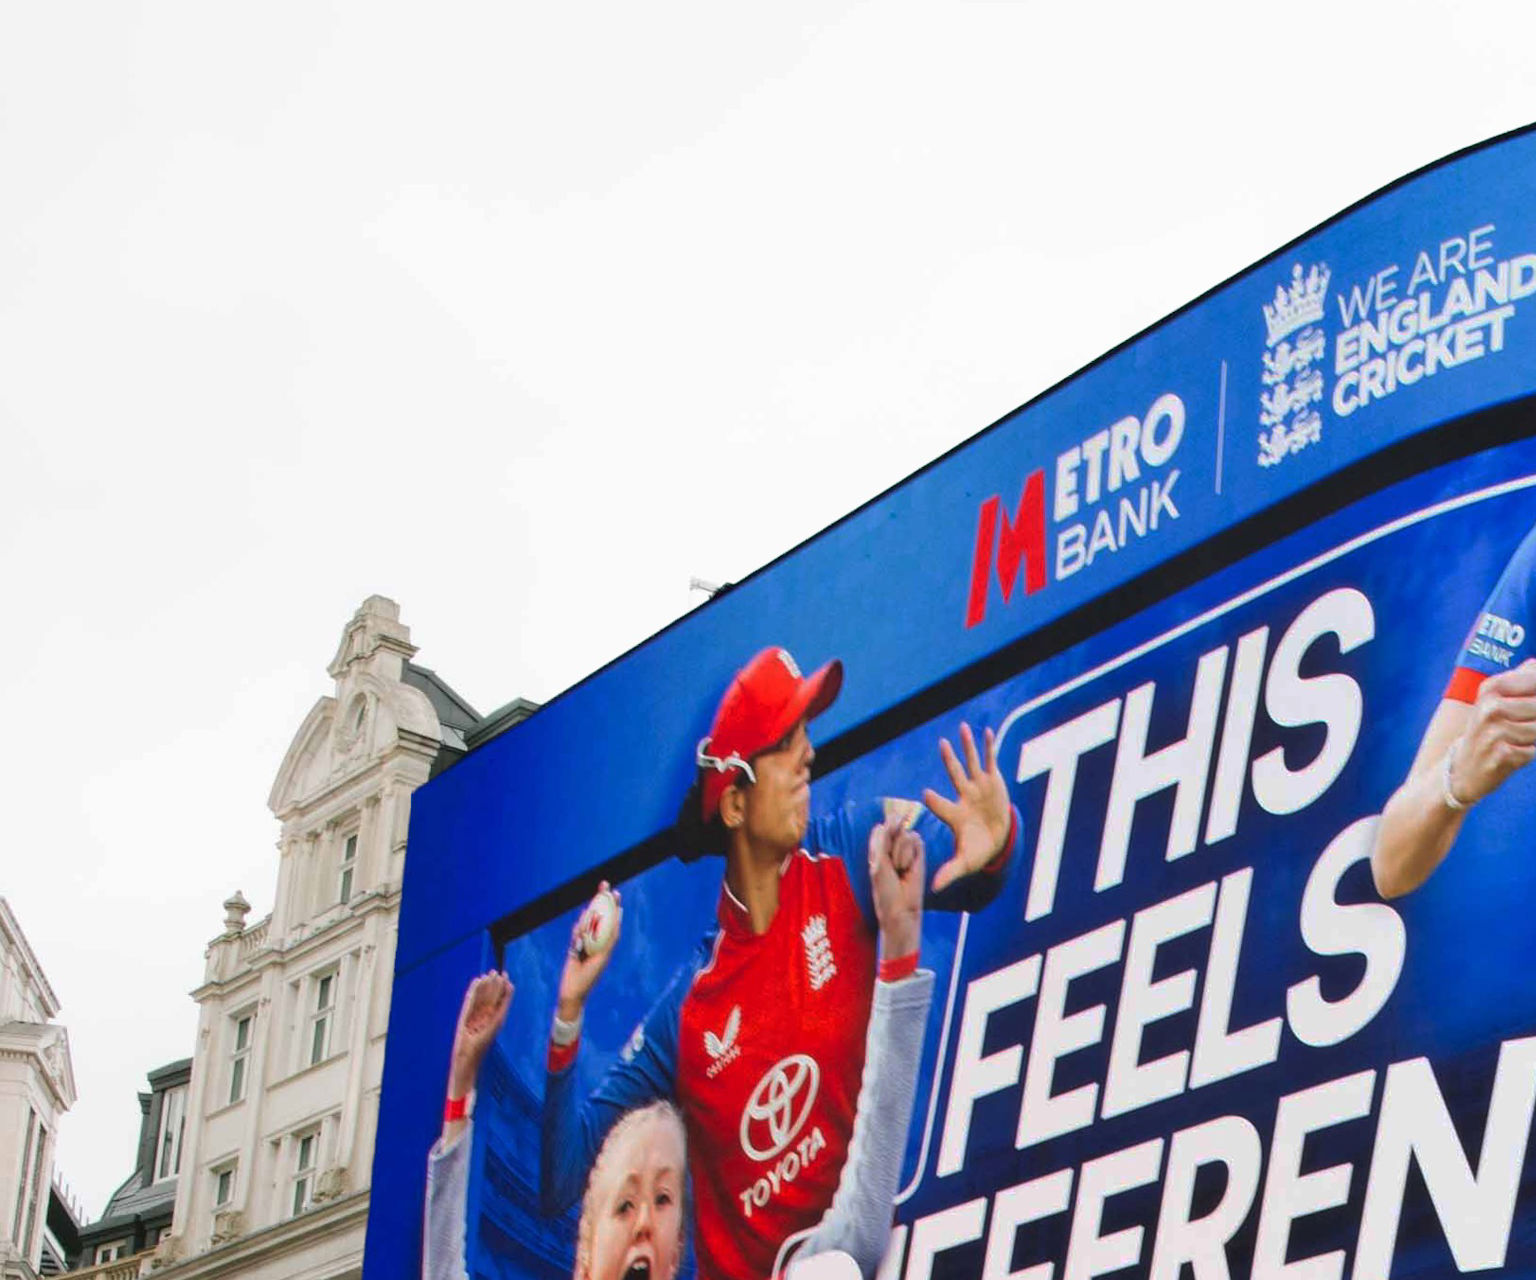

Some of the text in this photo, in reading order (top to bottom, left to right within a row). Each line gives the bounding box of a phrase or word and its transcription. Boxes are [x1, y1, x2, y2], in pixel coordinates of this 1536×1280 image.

[1337, 224, 1497, 328] WE ARE
[1331, 304, 1516, 417] CRICKET
[965, 393, 1187, 629] METRO
[1055, 469, 1183, 582] BANK
[1016, 587, 1377, 923] THIS
[935, 814, 1408, 1178] FEELS
[739, 1126, 827, 1217] TOYOTA
